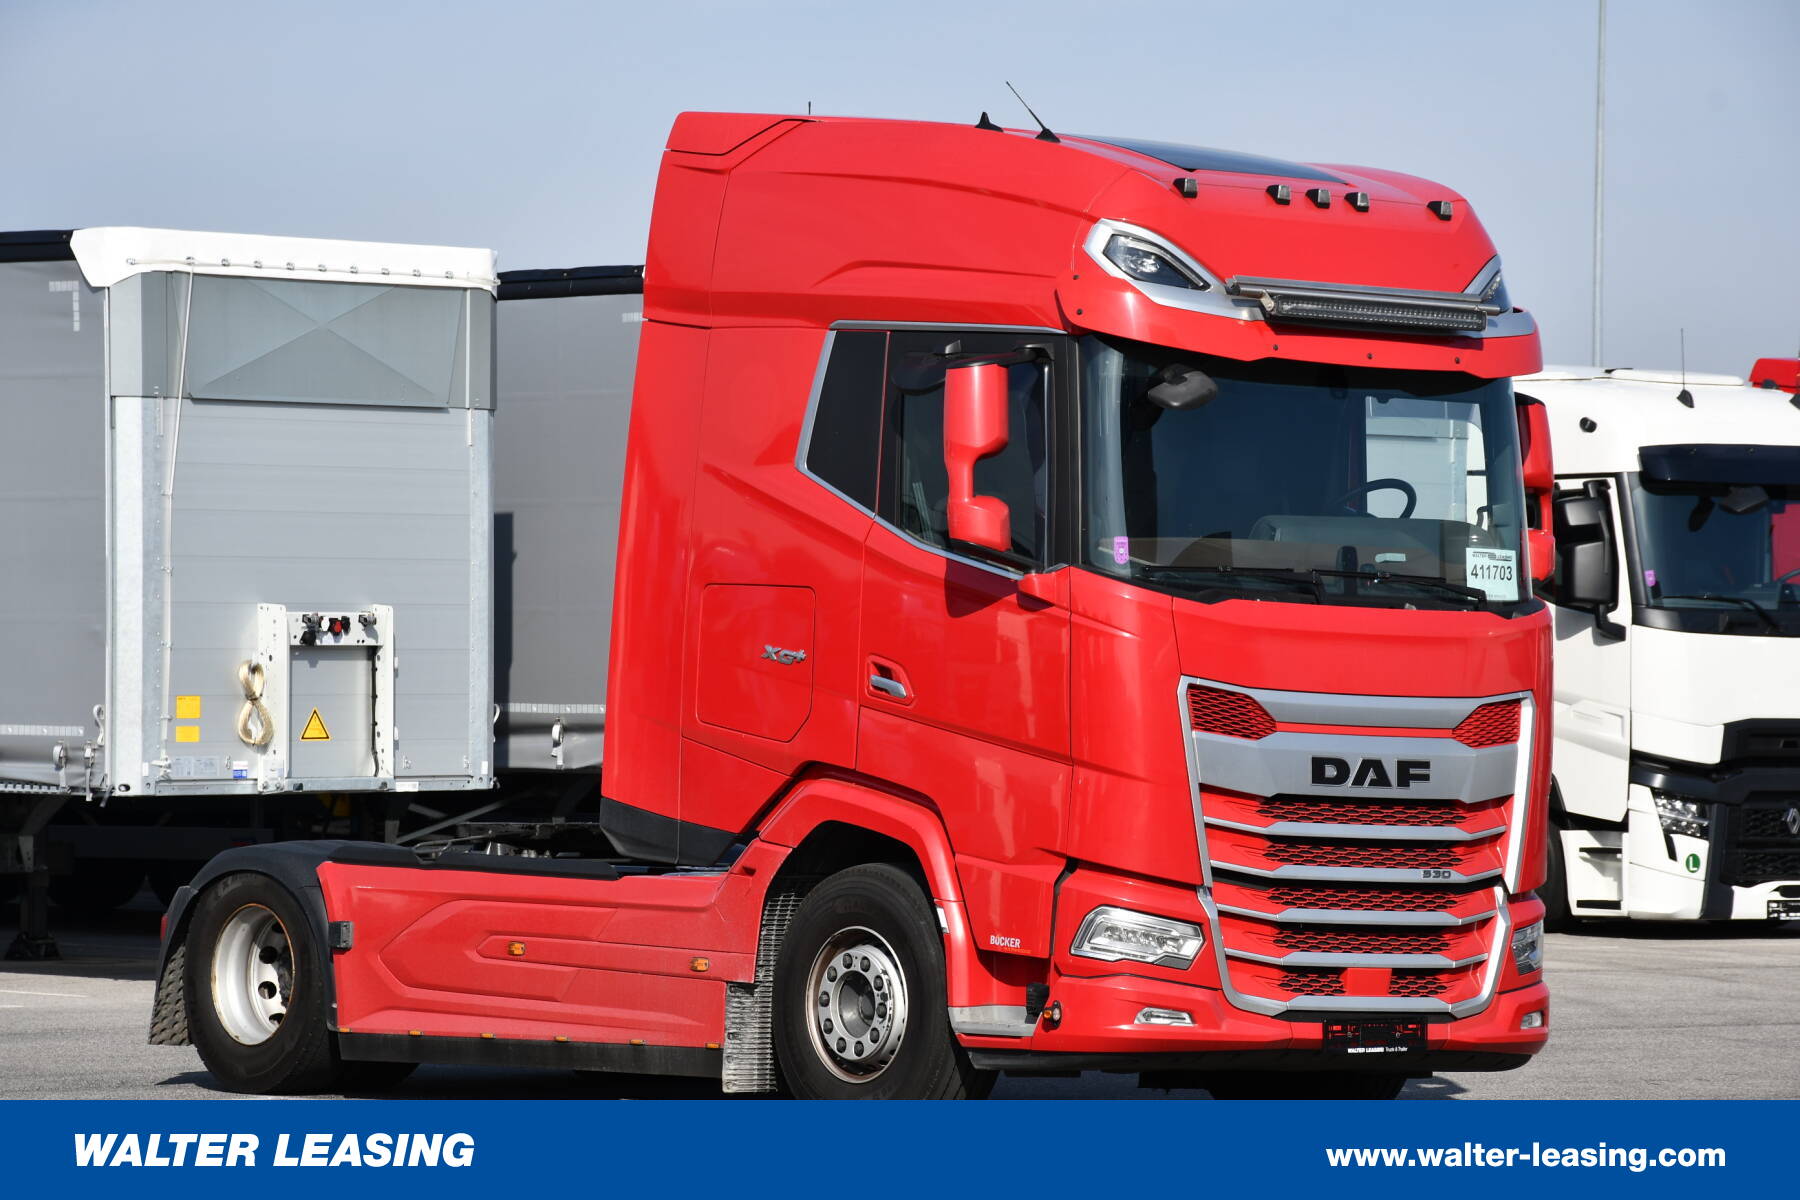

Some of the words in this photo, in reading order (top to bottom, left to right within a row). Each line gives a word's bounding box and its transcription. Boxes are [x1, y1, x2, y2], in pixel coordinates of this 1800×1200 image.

[1471, 564, 1512, 580] 411703
[1311, 756, 1431, 788] DAF
[1423, 870, 1451, 879] 530
